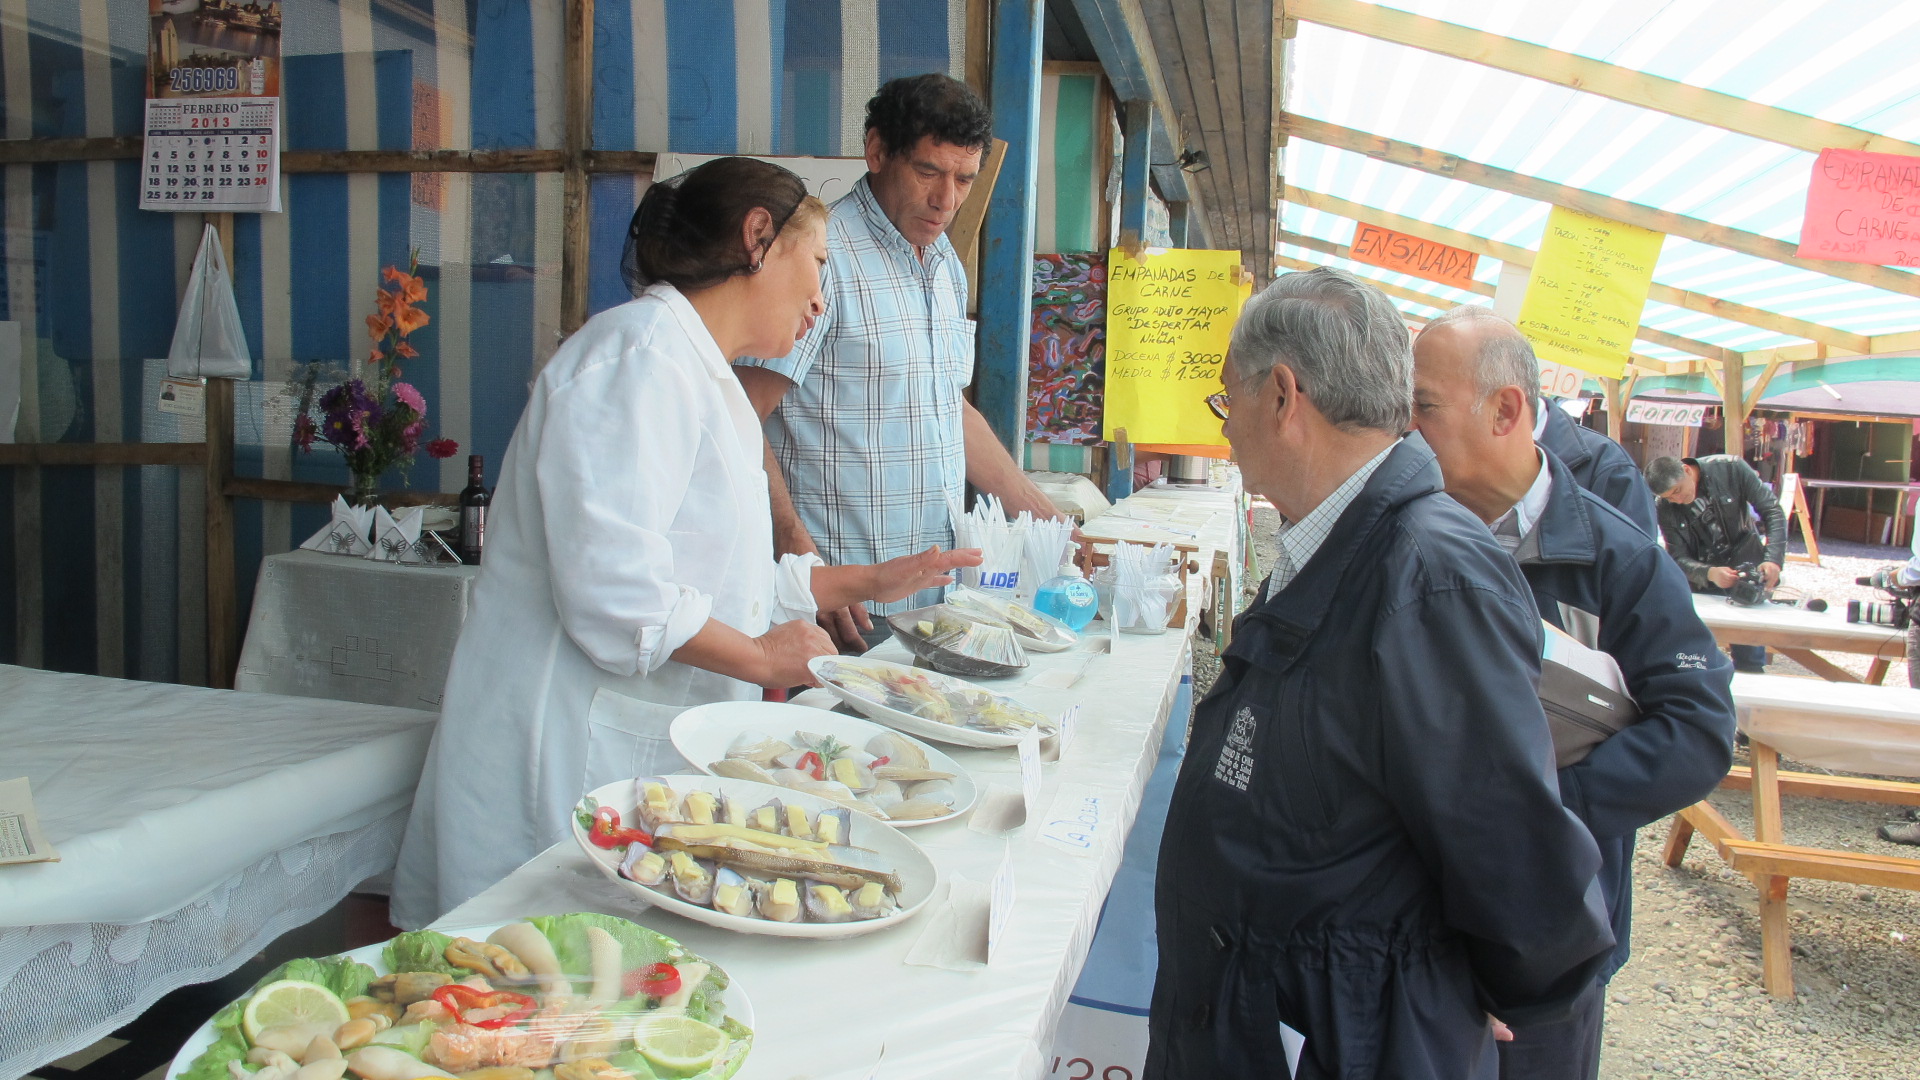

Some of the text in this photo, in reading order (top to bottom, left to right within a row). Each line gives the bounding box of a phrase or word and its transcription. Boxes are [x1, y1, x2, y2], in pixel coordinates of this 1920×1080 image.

[170, 67, 238, 91] 256969
[183, 103, 239, 114] FEBRERO
[191, 117, 230, 128] 2013
[259, 136, 266, 144] 3
[152, 150, 268, 159] 4 5 6 7 8 9 10
[150, 164, 268, 173] 11 12 13 14 15 16 17
[149, 177, 267, 186] 18 19 20 21 22 23 24
[147, 191, 214, 200] 25 26 27 28
[1881, 192, 1904, 212] DE
[1836, 209, 1908, 240] CARNE
[1353, 228, 1474, 280] ENSALADA
[1111, 265, 1197, 283] EMPANADAS
[1586, 268, 1612, 278] LECHE
[1616, 260, 1645, 275] HERBAS
[1536, 275, 1560, 290] TAZA
[1140, 283, 1193, 298] CARNE
[1112, 303, 1149, 319] GRUPO
[1186, 305, 1228, 320] MAYOR
[1572, 315, 1598, 326] LECHE
[1602, 314, 1631, 329] HERBAS
[1113, 349, 1160, 361] DOCENA
[1175, 365, 1217, 381] 1.500
[1629, 405, 1703, 424] FOTOS
